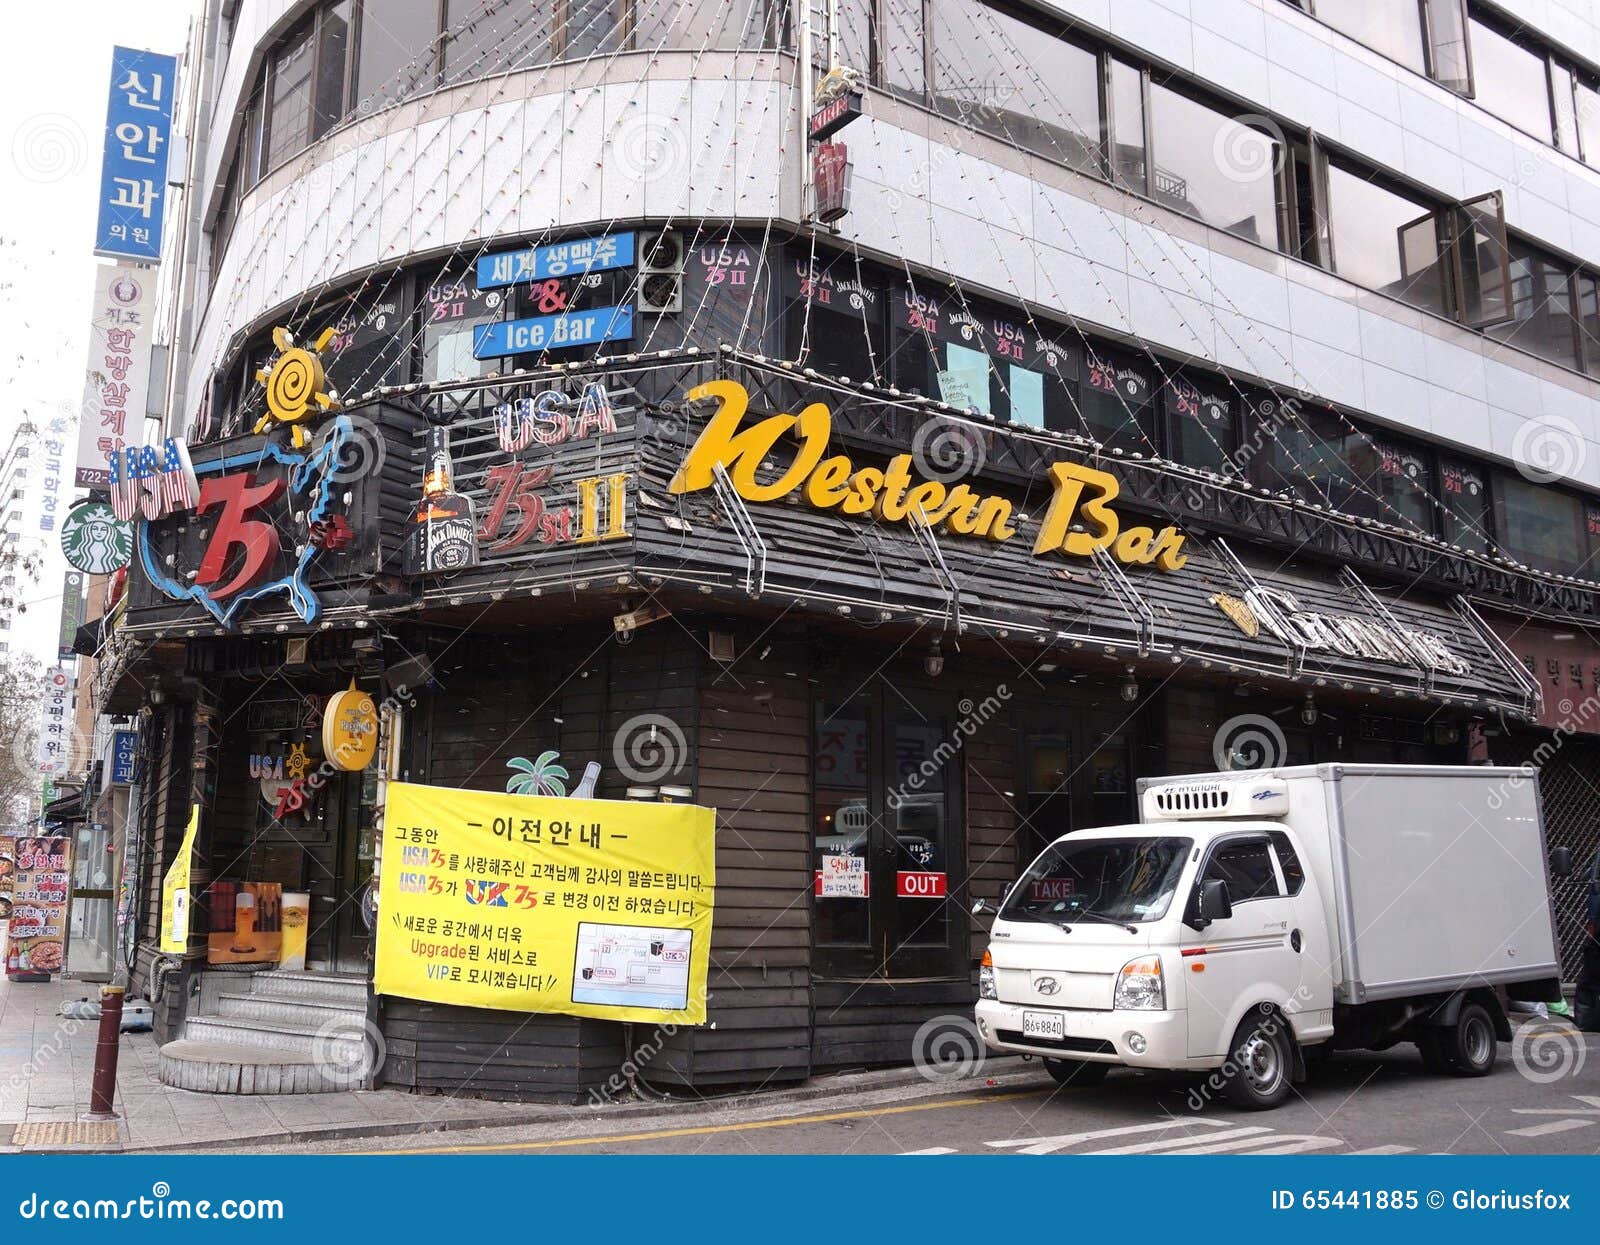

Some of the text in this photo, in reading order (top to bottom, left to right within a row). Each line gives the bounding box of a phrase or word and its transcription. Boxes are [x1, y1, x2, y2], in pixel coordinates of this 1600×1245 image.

[812, 97, 849, 131] KIRIN
[109, 69, 164, 219] 신안과
[109, 224, 150, 244] 의원
[491, 236, 618, 282] 세계 생맥주
[701, 248, 751, 267] USA
[794, 258, 834, 287] USA
[428, 281, 468, 303] USA
[904, 290, 939, 317] USA
[507, 316, 596, 350] Ice Bar
[993, 319, 1025, 344] USA
[494, 382, 617, 453] USA
[109, 436, 195, 522] USA
[668, 379, 1188, 572] Western Bar
[194, 471, 287, 600] 75
[249, 754, 283, 780] USA
[395, 826, 439, 846] 그동안
[492, 816, 601, 849] 이전안내
[401, 845, 429, 868] USA
[448, 853, 460, 872] 를
[464, 855, 526, 878] 사랑해주신
[531, 862, 580, 885] 고객님께
[586, 866, 622, 887] 감사의
[627, 868, 705, 893] 말씀드립니다.
[905, 874, 939, 894] OUT
[399, 872, 427, 895] USA
[446, 880, 458, 897] 가
[465, 878, 511, 908] UK
[514, 884, 539, 910] 75
[543, 891, 556, 907] 로
[562, 891, 588, 911] 변경
[593, 892, 623, 912] 이전
[625, 896, 699, 918] 하였습니다.
[1032, 882, 1073, 899] TAKE
[403, 913, 522, 944] 새로운 공간에서 더욱
[486, 945, 537, 967] 서비스로
